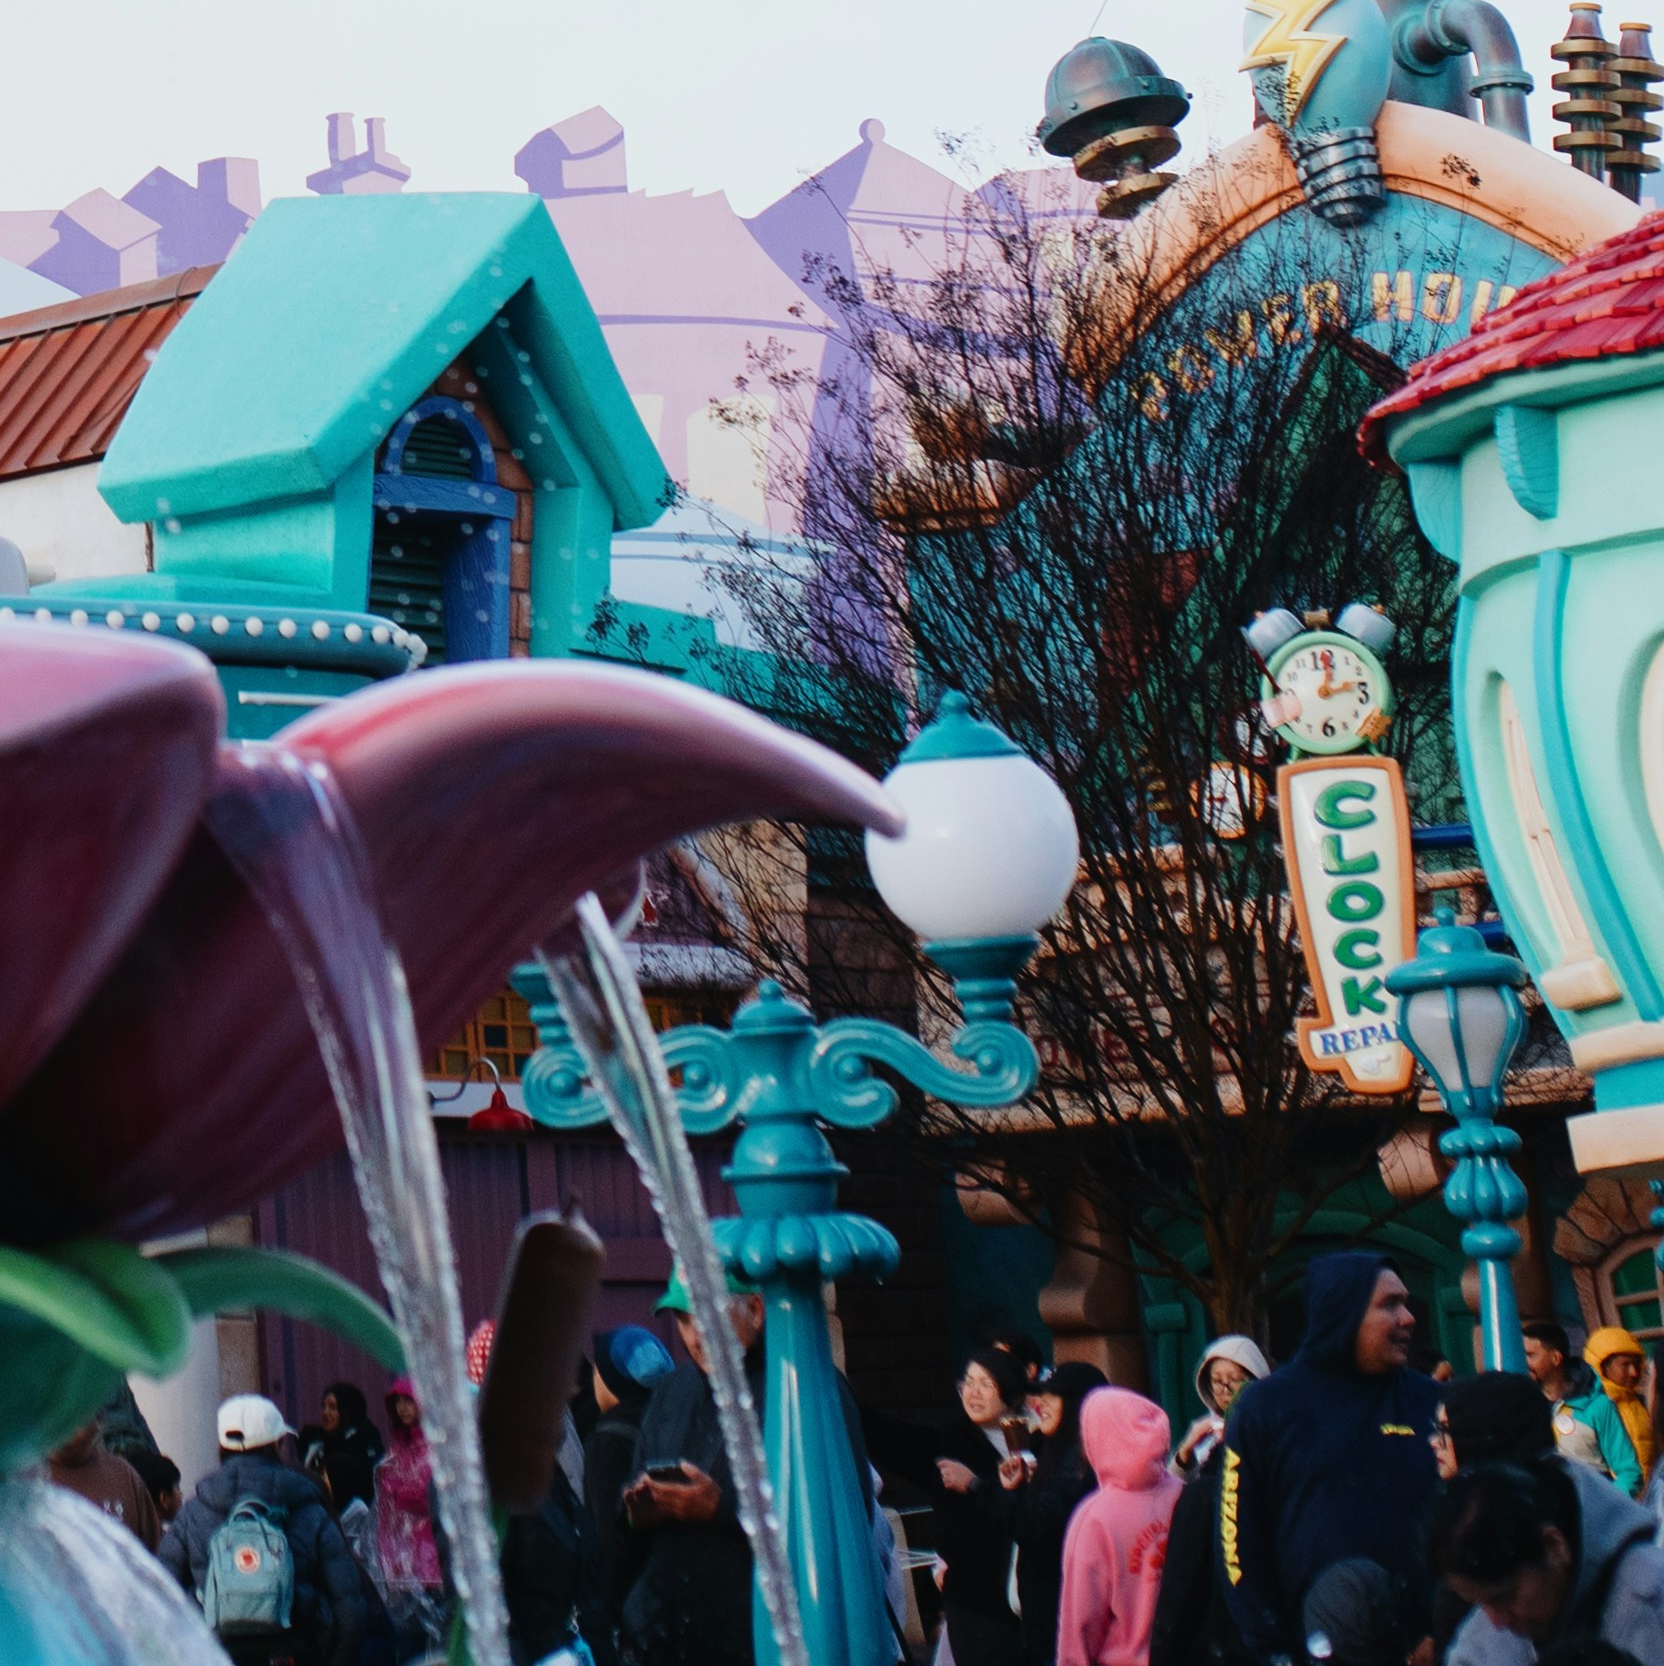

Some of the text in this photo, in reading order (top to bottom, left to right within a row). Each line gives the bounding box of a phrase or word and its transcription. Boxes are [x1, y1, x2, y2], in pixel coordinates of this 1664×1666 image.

[1372, 271, 1518, 328] HOU
[1357, 681, 1369, 704] 3
[1323, 716, 1336, 737] 6
[1314, 780, 1388, 1016] CLOCK
[1320, 1021, 1399, 1055] REPA
[1221, 1446, 1243, 1587] ARIZONA
